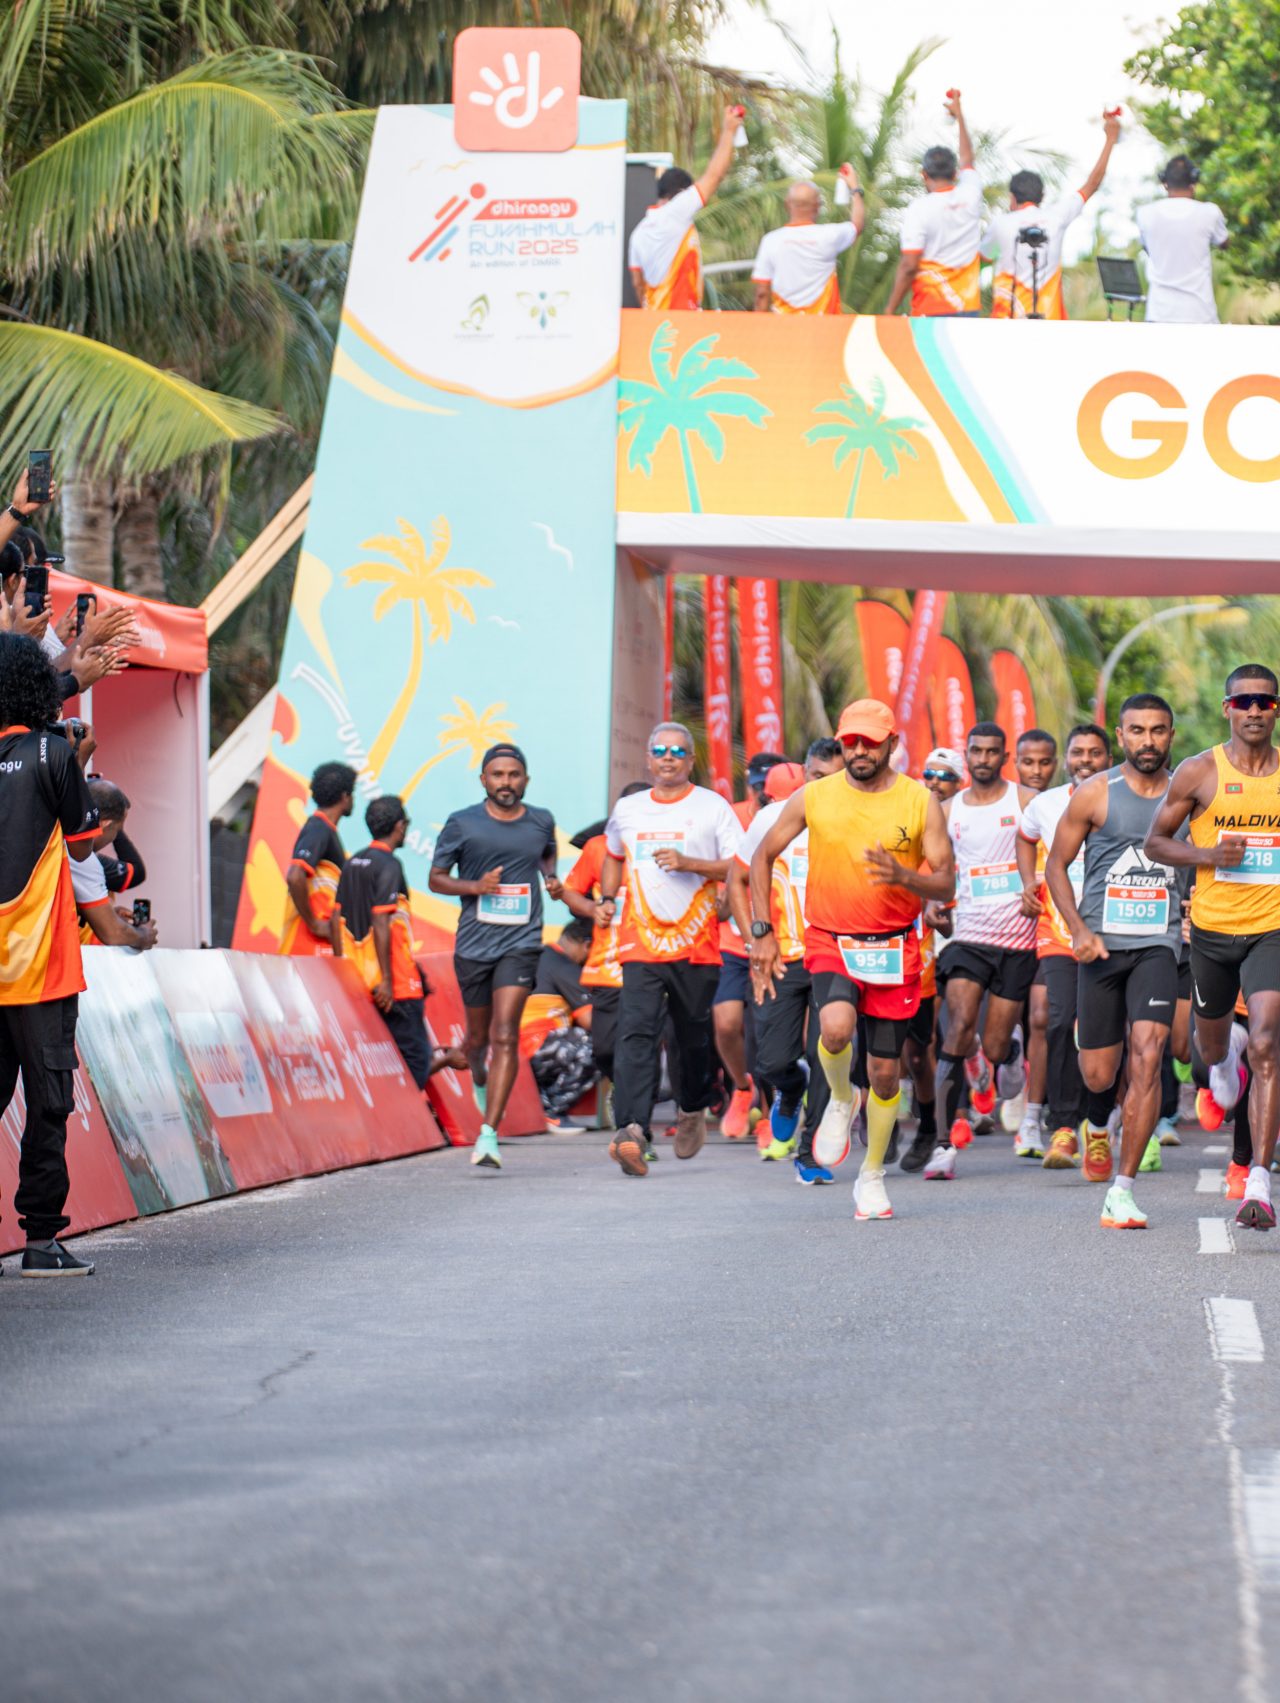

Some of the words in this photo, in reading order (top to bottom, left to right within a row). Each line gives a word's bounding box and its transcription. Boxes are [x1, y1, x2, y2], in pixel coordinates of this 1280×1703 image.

[491, 200, 572, 217] dhiraagu
[469, 221, 616, 238] FUVAHMULAH
[469, 241, 514, 255] RUN
[518, 239, 579, 255] 2025
[1241, 851, 1273, 867] 218
[1117, 903, 1157, 918] 1505
[855, 953, 888, 967] 954
